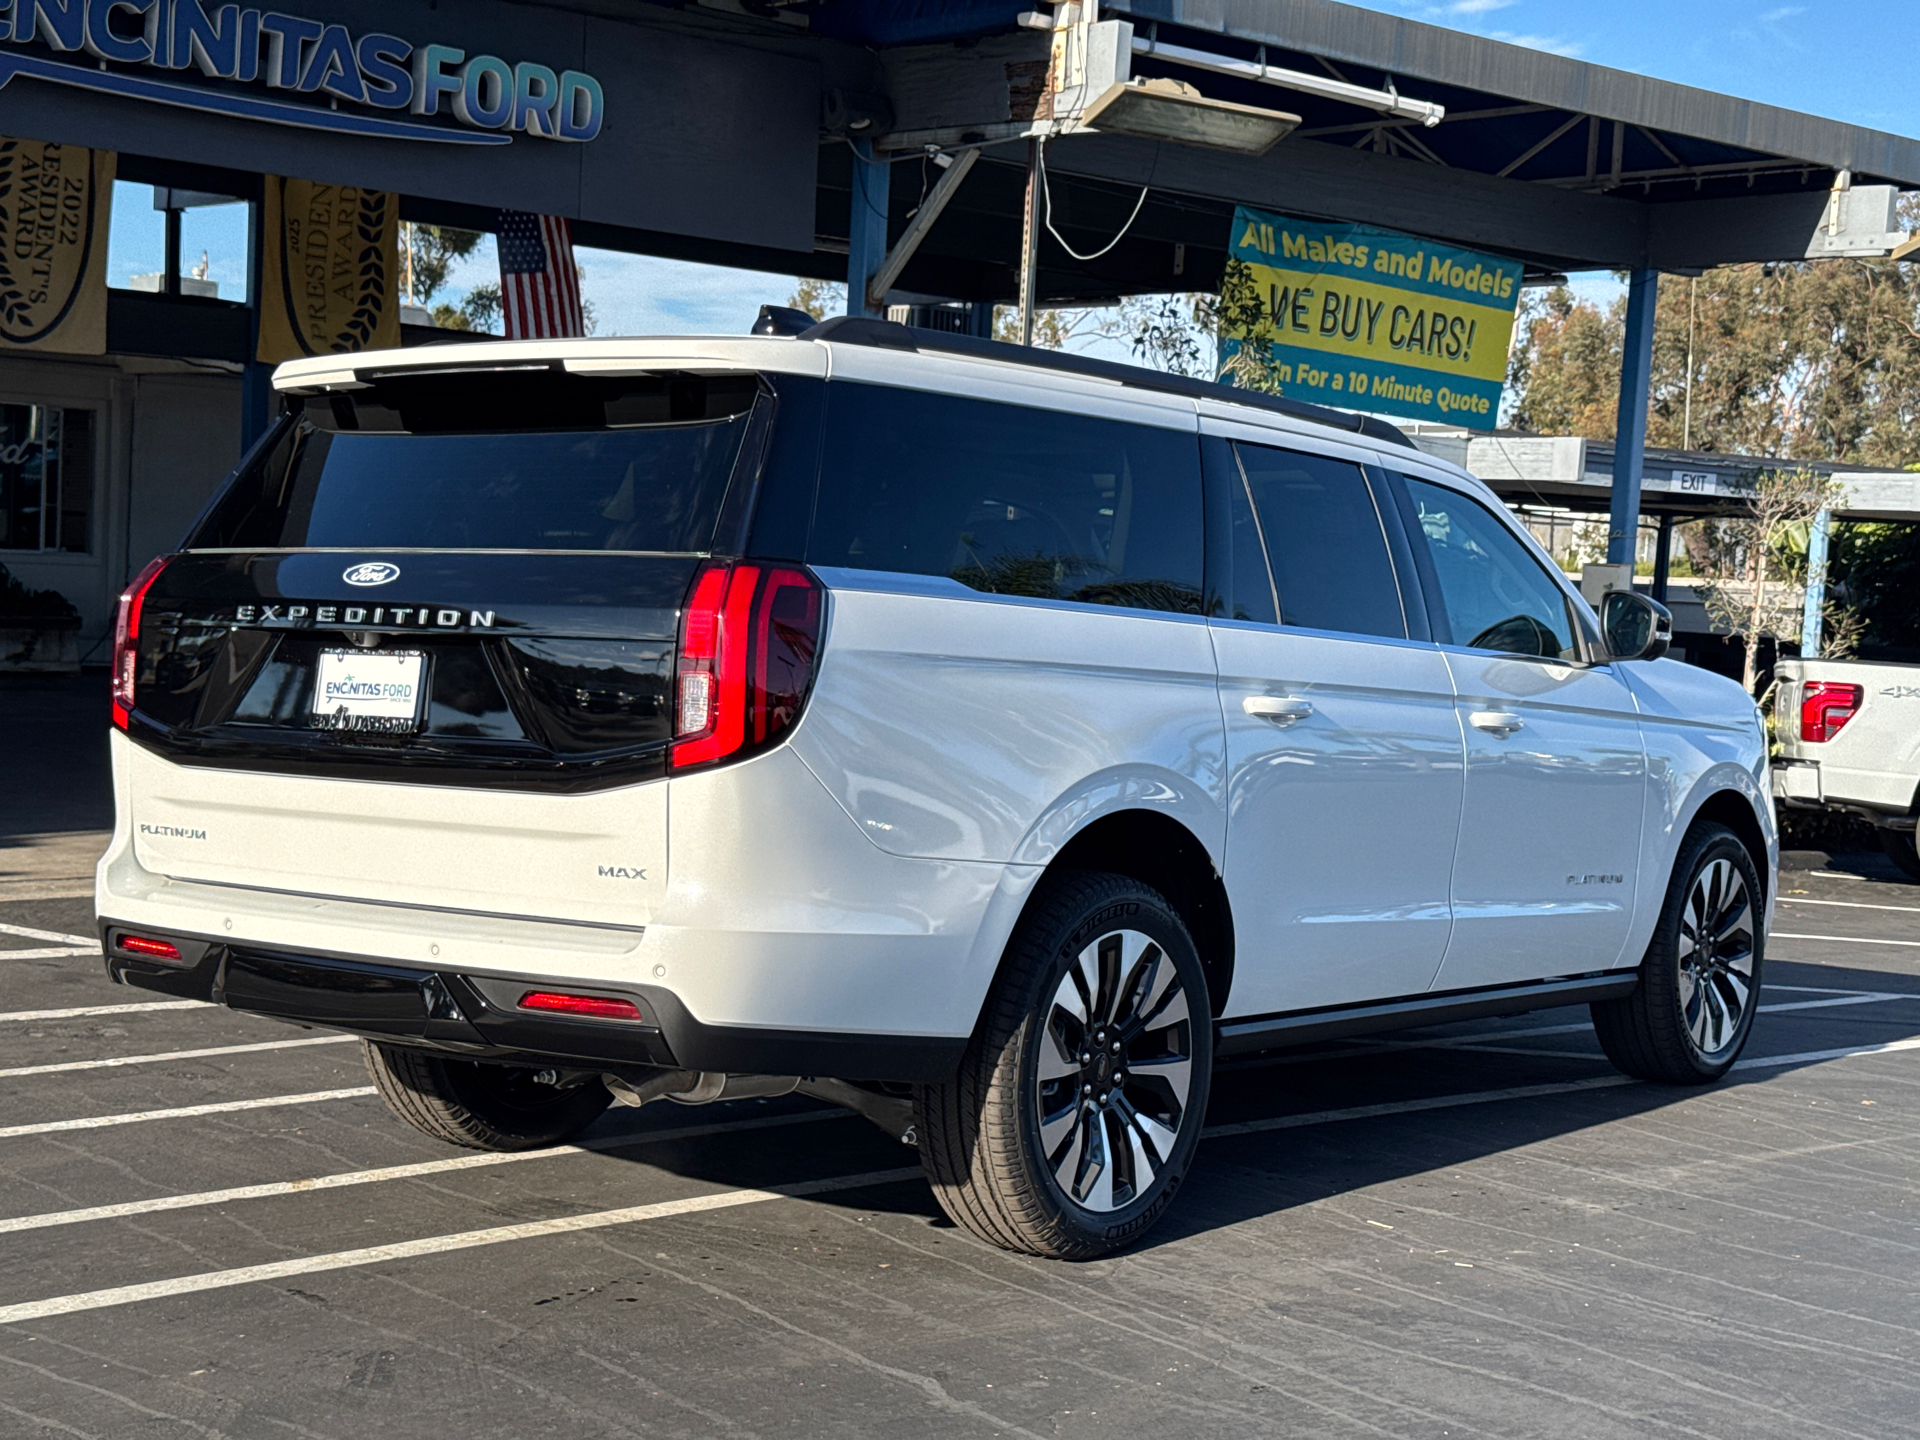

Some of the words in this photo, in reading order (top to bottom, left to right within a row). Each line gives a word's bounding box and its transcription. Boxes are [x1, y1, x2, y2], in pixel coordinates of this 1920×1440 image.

[410, 44, 604, 143] FORD
[14, 153, 40, 260] AWARD
[59, 178, 84, 247] 2022
[1238, 221, 1276, 256] All
[1282, 230, 1370, 269] Makes
[1373, 249, 1424, 281] and
[1427, 255, 1514, 299] Models
[1270, 283, 1315, 334] WE
[1319, 290, 1386, 345] BUY
[1389, 304, 1477, 362] CARS!
[1296, 363, 1329, 388] For
[1331, 373, 1344, 391] a
[1348, 371, 1369, 394] 10
[1371, 375, 1433, 405] Minute
[1436, 387, 1491, 414] Quote
[1681, 473, 1708, 492] EXIT
[349, 563, 393, 583] Ford
[235, 605, 496, 627] EXPEDITION
[326, 682, 382, 695] ENCINITAS
[383, 684, 412, 698] FORD
[140, 823, 207, 840] PLATINUM
[598, 865, 648, 881] MAX
[1565, 873, 1624, 885] PLATINUM
[1079, 903, 1138, 939] MICHELIN
